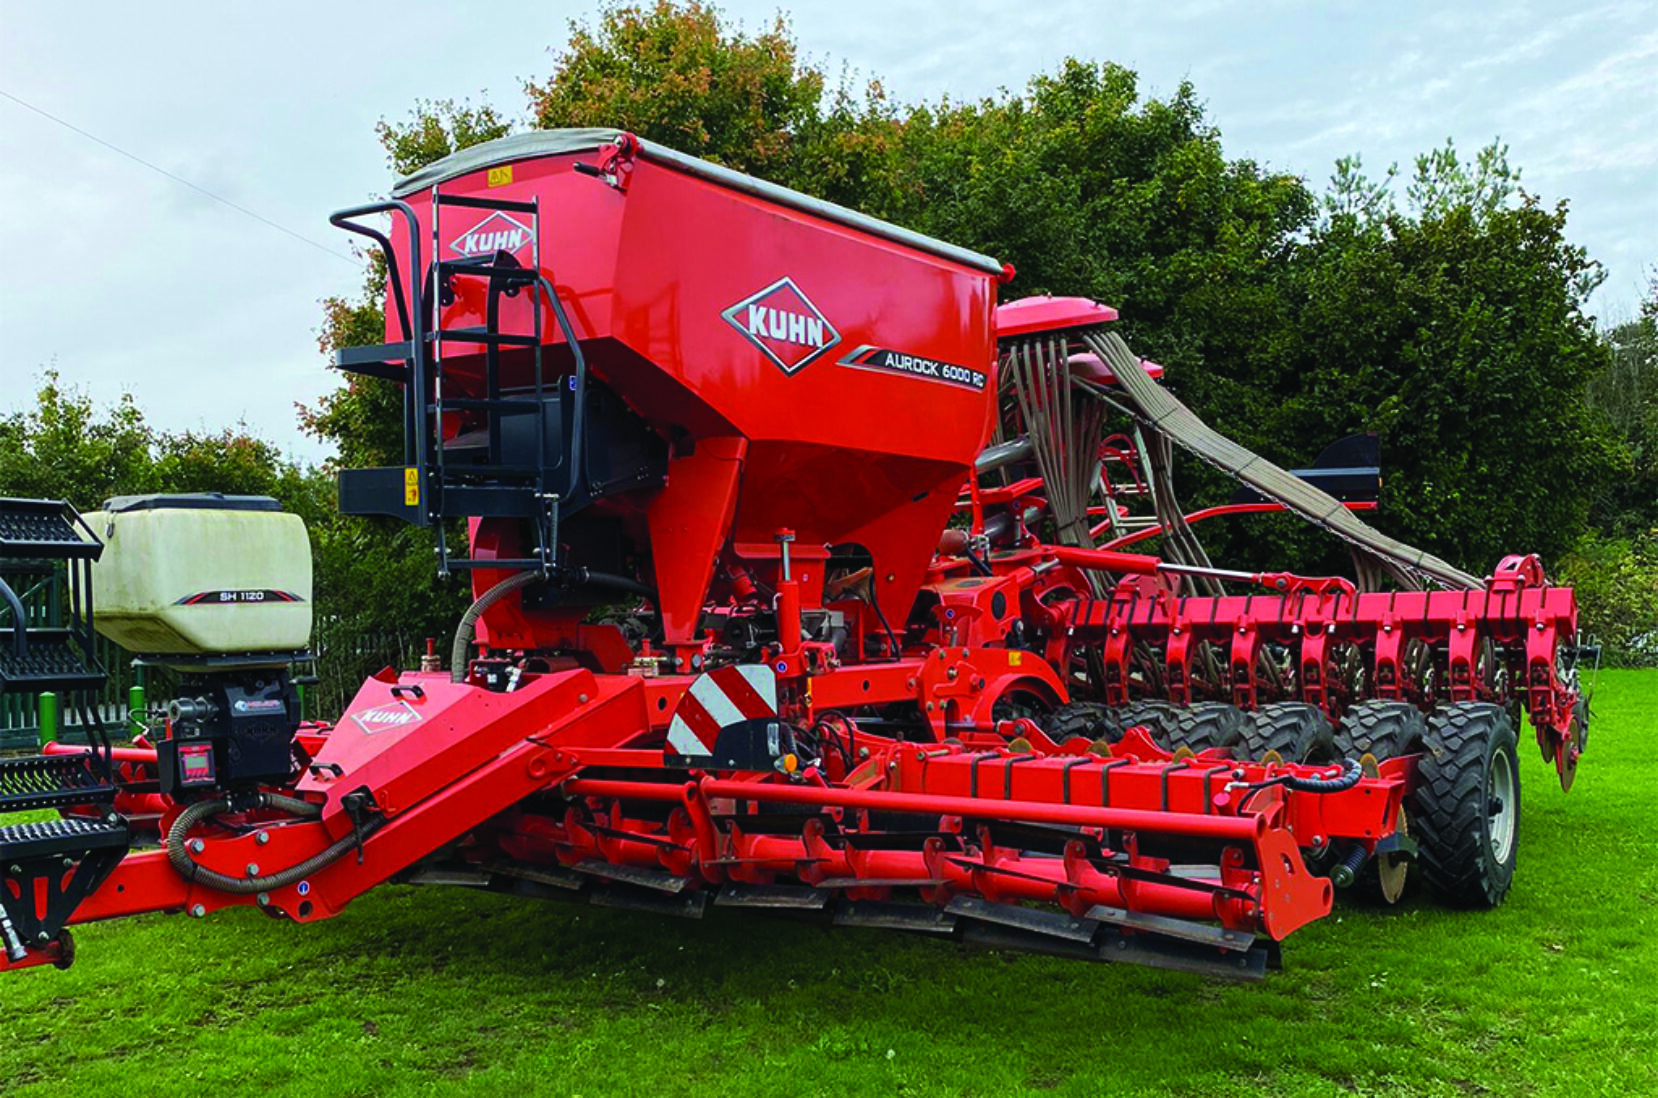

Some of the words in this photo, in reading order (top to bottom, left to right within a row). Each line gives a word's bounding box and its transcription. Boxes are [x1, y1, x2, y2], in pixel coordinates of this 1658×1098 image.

[464, 228, 523, 253] KUHN
[748, 303, 824, 348] KUHN
[885, 352, 940, 377] AUROCK
[942, 364, 971, 383] 6000
[972, 372, 984, 387] RC
[220, 592, 237, 601] SH
[241, 591, 265, 601] 1120
[360, 709, 413, 724] KUHN
